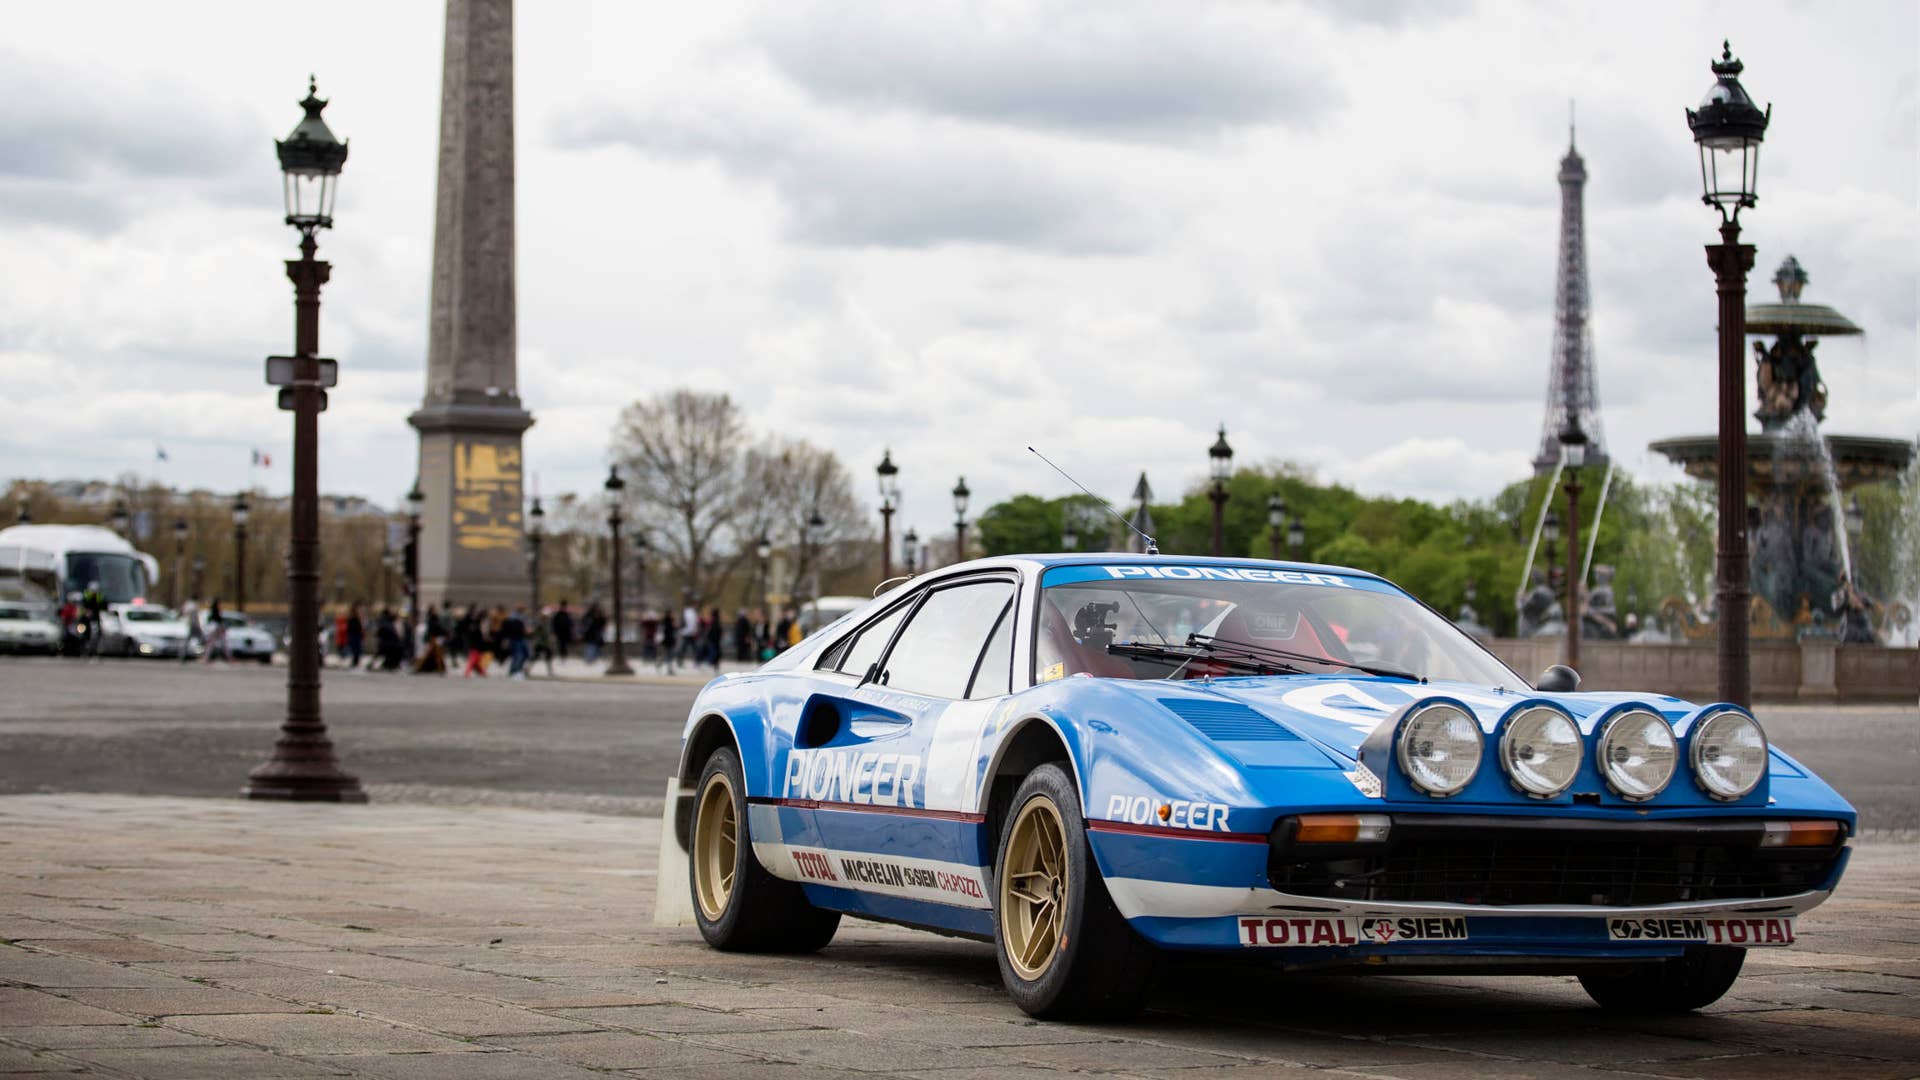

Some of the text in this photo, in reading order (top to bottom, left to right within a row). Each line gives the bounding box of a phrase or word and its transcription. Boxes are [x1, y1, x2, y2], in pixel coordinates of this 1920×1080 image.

[1102, 566, 1351, 587] PIONEER
[783, 749, 921, 809] PIONEER
[1106, 795, 1231, 832] PIONEER
[792, 851, 838, 881] TOTAL
[841, 859, 905, 887] MICHELIN
[914, 868, 939, 888] SIEM
[1241, 918, 1467, 944] TOTAL SIEM
[1644, 919, 1705, 939] SIEM
